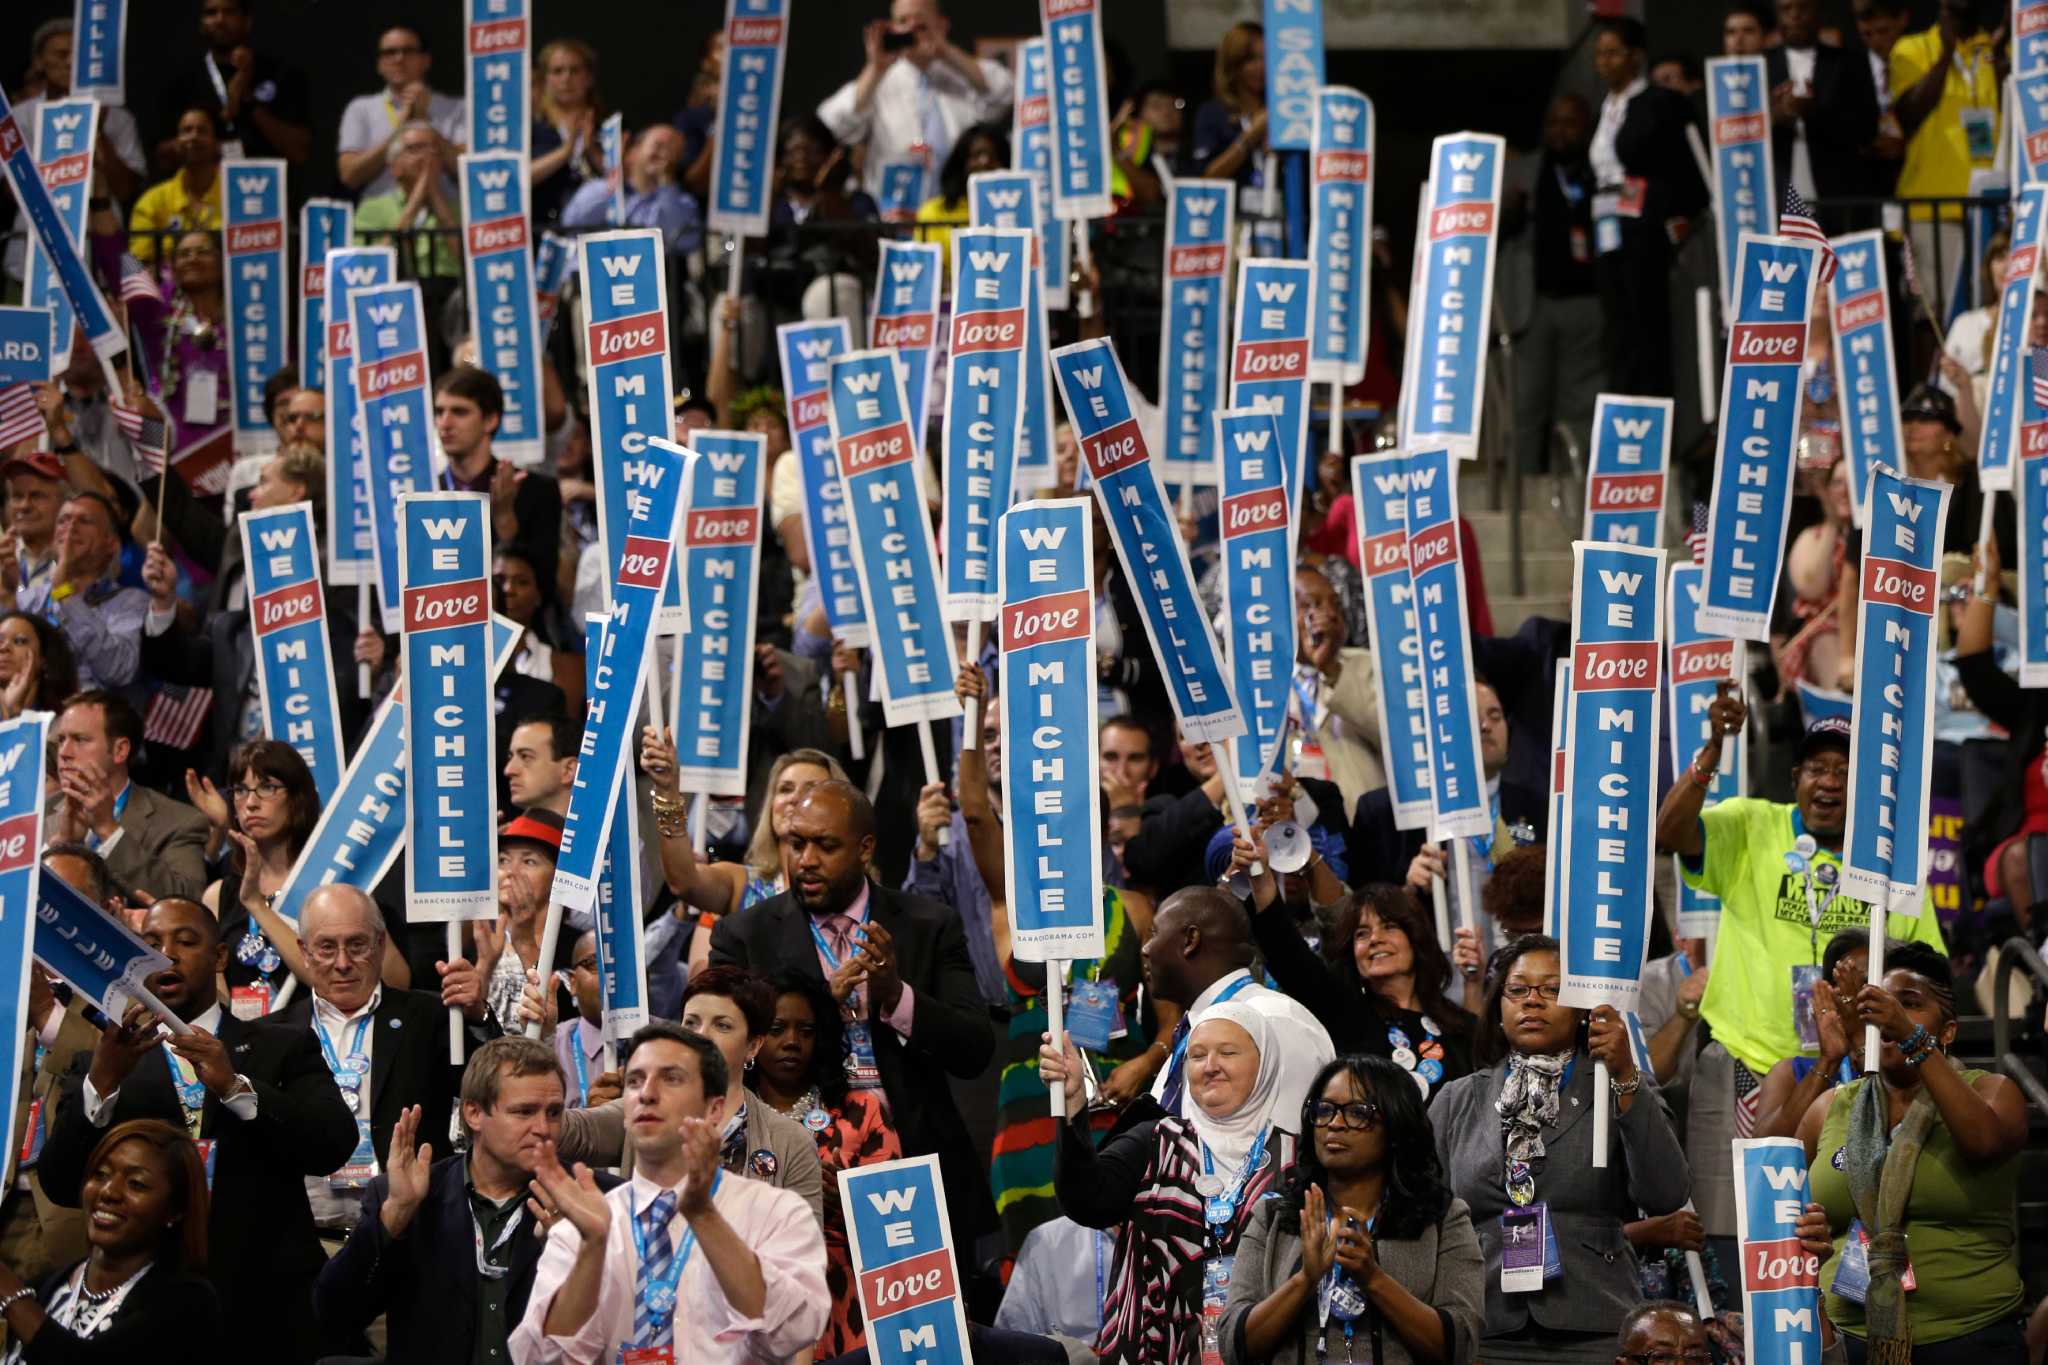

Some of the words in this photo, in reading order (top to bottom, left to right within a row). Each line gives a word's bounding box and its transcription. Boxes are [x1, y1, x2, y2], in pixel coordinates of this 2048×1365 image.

[475, 26, 521, 49] love
[485, 62, 511, 145] MICH
[1059, 25, 1089, 190] MICHELLE
[1721, 73, 1751, 107] WE
[729, 55, 765, 208] MICHELLE
[1327, 104, 1361, 144] WE
[1319, 154, 1365, 177] love
[1449, 152, 1485, 193] WE
[237, 176, 269, 215] WE
[476, 171, 509, 212] WE
[231, 230, 277, 250] love
[473, 224, 523, 247] love
[1184, 197, 1217, 238] WE
[1437, 207, 1486, 232] love
[602, 255, 642, 306] WE
[891, 263, 923, 305] WE
[967, 251, 1010, 299] WE
[1174, 250, 1221, 274] love
[1327, 193, 1354, 353] MICHELLE
[1839, 249, 1867, 289] WE
[1255, 282, 1297, 330] WE
[1759, 260, 1798, 312] WE
[367, 303, 404, 348] WE
[877, 321, 925, 344] love
[958, 319, 1016, 344] love
[1432, 247, 1472, 424] MICHELLE
[1839, 301, 1879, 330] love
[241, 263, 268, 424] MICHELLE
[486, 263, 523, 435] MICHELLE
[599, 325, 656, 356] love
[797, 338, 833, 382] WE
[1242, 351, 1300, 374] love
[1737, 330, 1797, 357] love
[367, 364, 418, 393] love
[1072, 365, 1110, 418] WE
[1181, 287, 1209, 456] MICHELLE
[842, 371, 882, 420] WE
[848, 435, 904, 467] love
[1233, 431, 1271, 480] WE
[1612, 417, 1652, 465] WE
[632, 464, 666, 521] WE
[708, 453, 745, 498] WE
[966, 366, 999, 581] MICHELLE
[1411, 468, 1437, 518] WE
[1597, 480, 1656, 505] love
[1728, 378, 1780, 599] MICHELLE
[694, 514, 749, 539] love
[1229, 500, 1283, 529] love
[1887, 492, 1924, 553] WE
[260, 528, 298, 578] WE
[421, 518, 468, 571] WE
[1019, 527, 1067, 583] WE
[1413, 534, 1450, 567] love
[868, 480, 932, 684] MICHELLE
[1119, 485, 1207, 704] MICHELLE
[1598, 569, 1643, 629] WE
[1873, 566, 1926, 602] love
[262, 594, 314, 626] love
[414, 595, 479, 623] love
[1013, 606, 1080, 640] love
[696, 559, 736, 758] MICHELLE
[1241, 548, 1274, 764] MICHELLE
[1584, 652, 1649, 681] love
[1679, 650, 1733, 675] love
[277, 640, 317, 767] MICHE
[1423, 584, 1460, 799] MICHELLE
[430, 644, 466, 878] MICHELLE
[1876, 619, 1910, 865] MICHELLE
[1028, 661, 1065, 913] MICHELLE
[1593, 707, 1634, 962] MICHELLE
[867, 1186, 917, 1248] WE
[1760, 1165, 1808, 1225] WE
[875, 1268, 942, 1307] love
[1757, 1250, 1819, 1281] love
